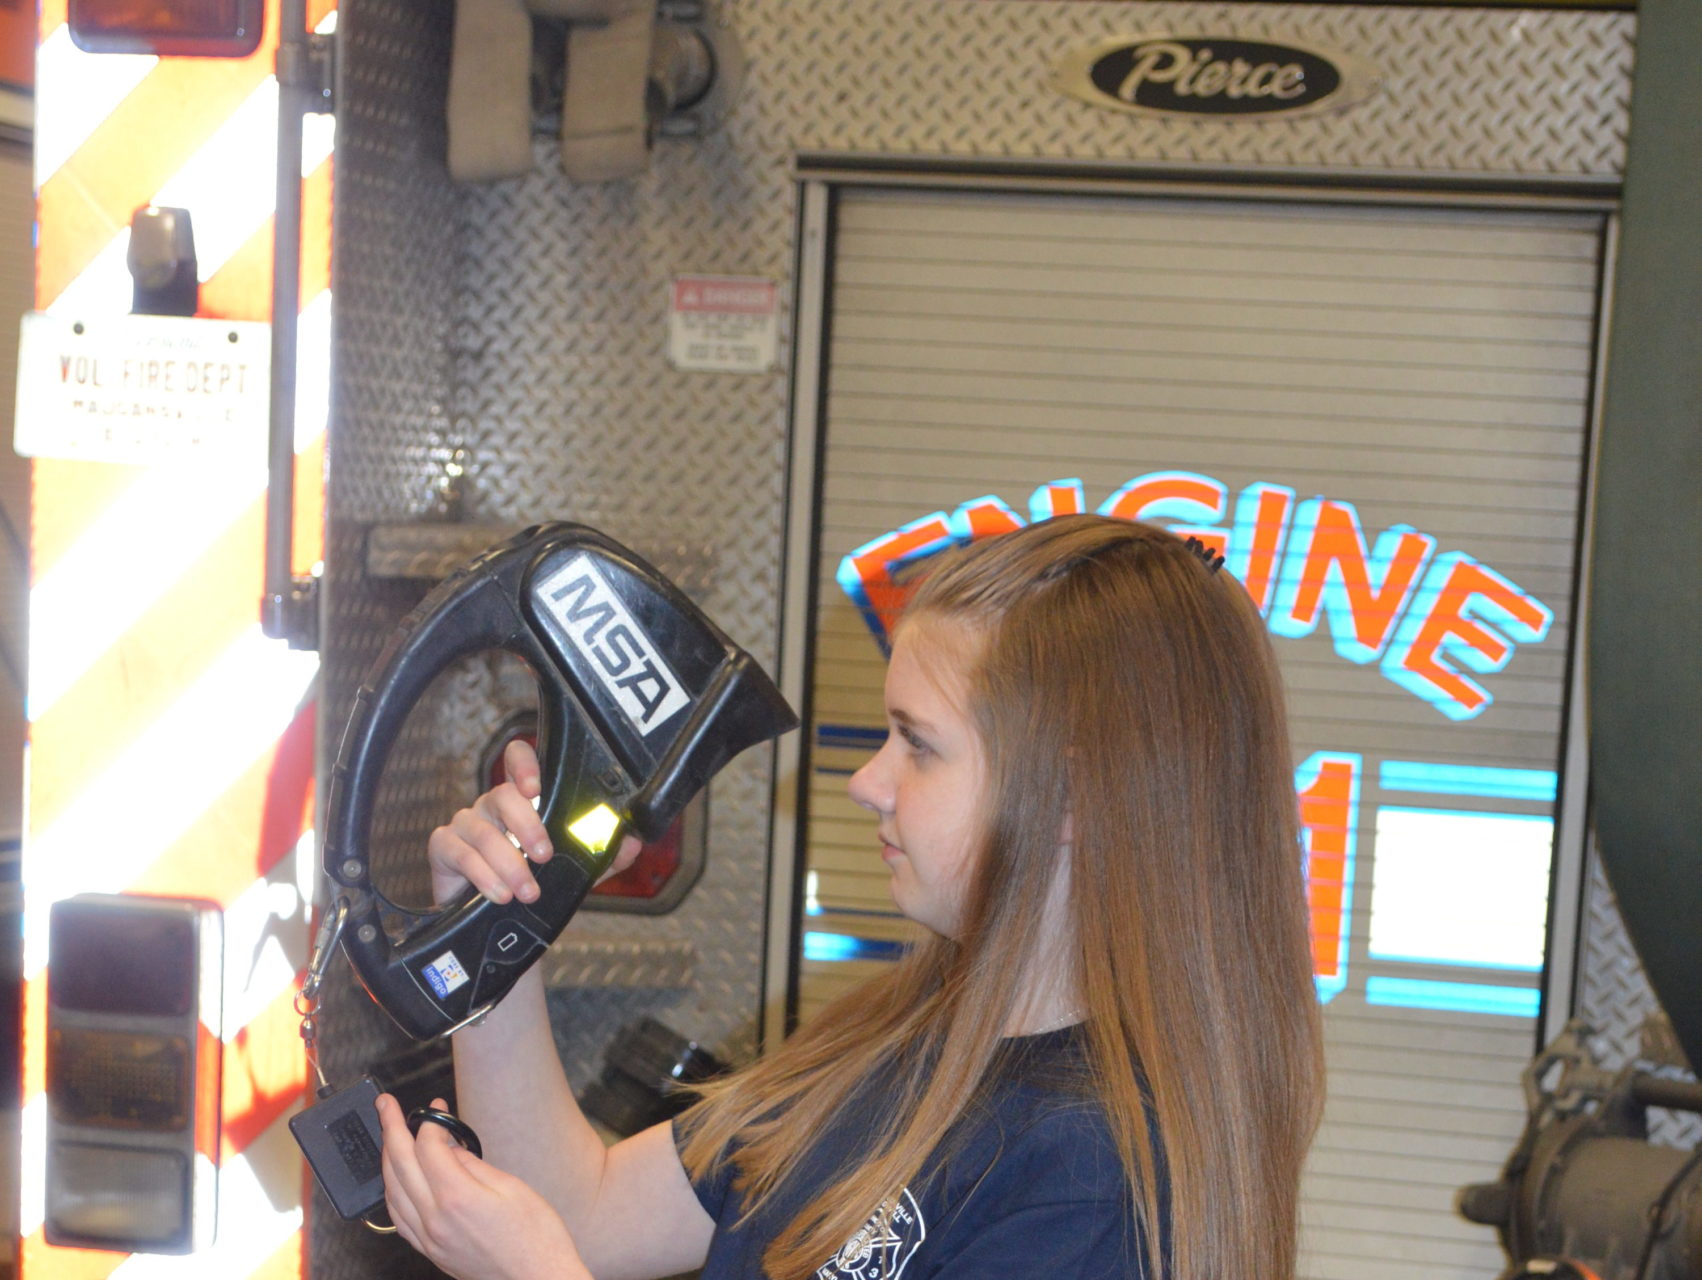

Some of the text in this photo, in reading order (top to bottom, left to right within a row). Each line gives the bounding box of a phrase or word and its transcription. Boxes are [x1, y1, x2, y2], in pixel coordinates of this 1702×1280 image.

[1117, 42, 1306, 102] Pierce
[59, 353, 249, 397] VOL FIRE DEPT
[550, 574, 671, 724] MSA
